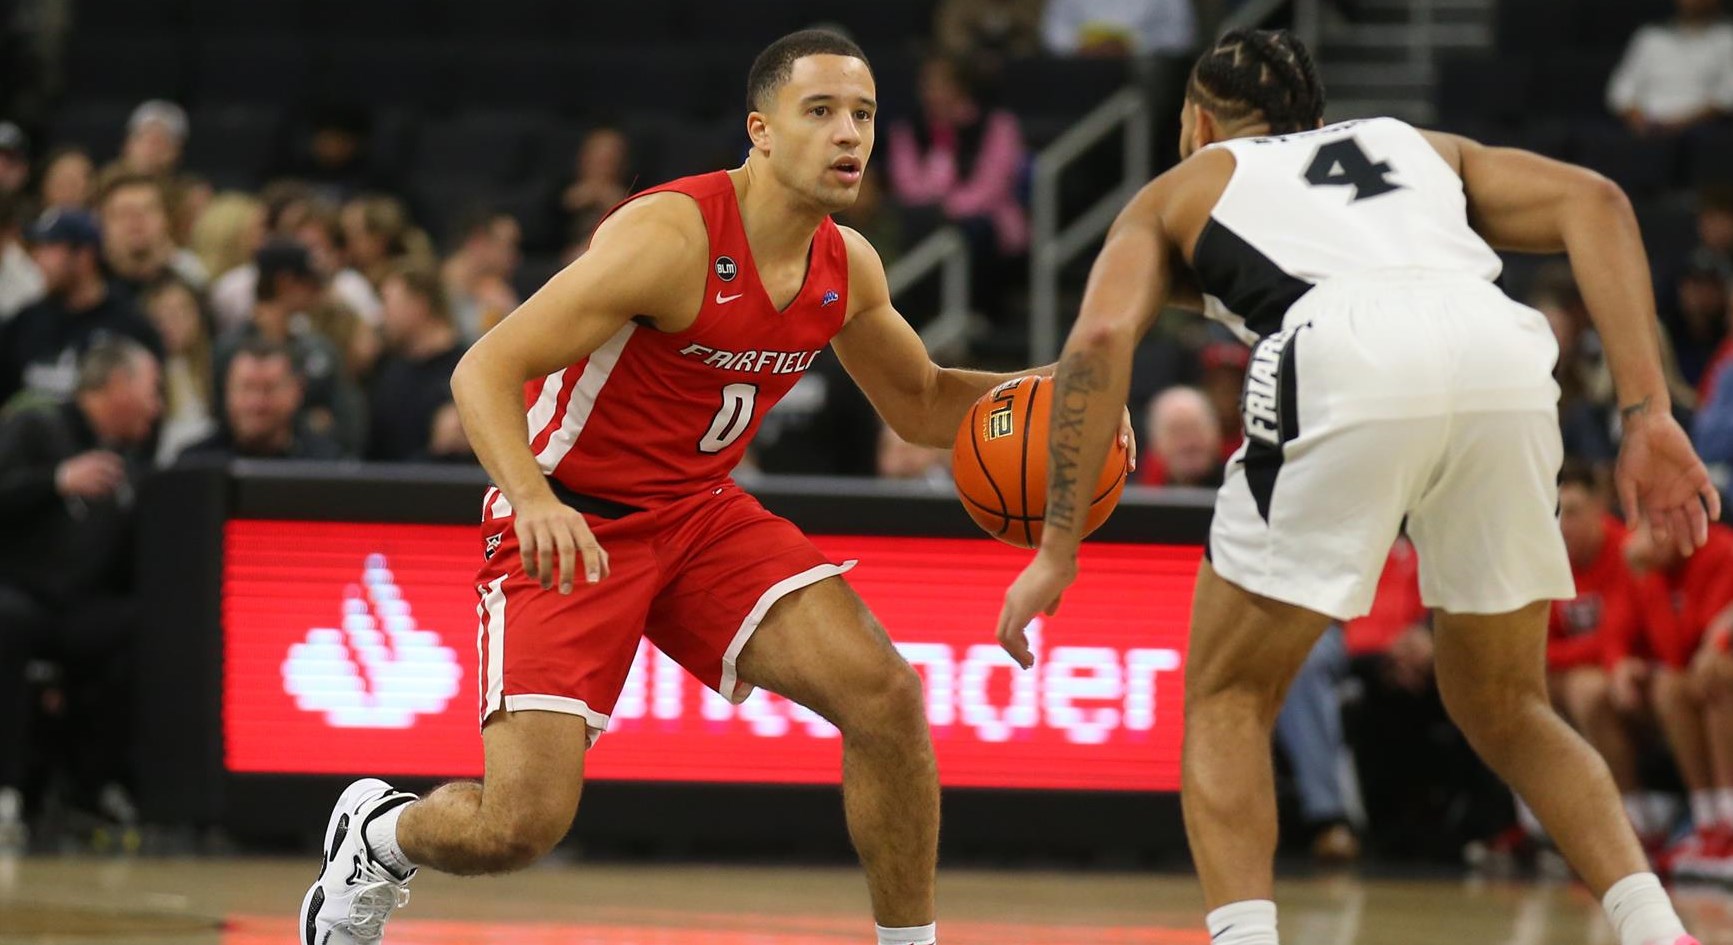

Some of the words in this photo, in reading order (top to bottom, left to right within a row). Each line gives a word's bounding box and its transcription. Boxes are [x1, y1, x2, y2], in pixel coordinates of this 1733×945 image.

[1301, 136, 1408, 204] 4
[716, 262, 735, 275] BLM
[698, 382, 760, 455] 0
